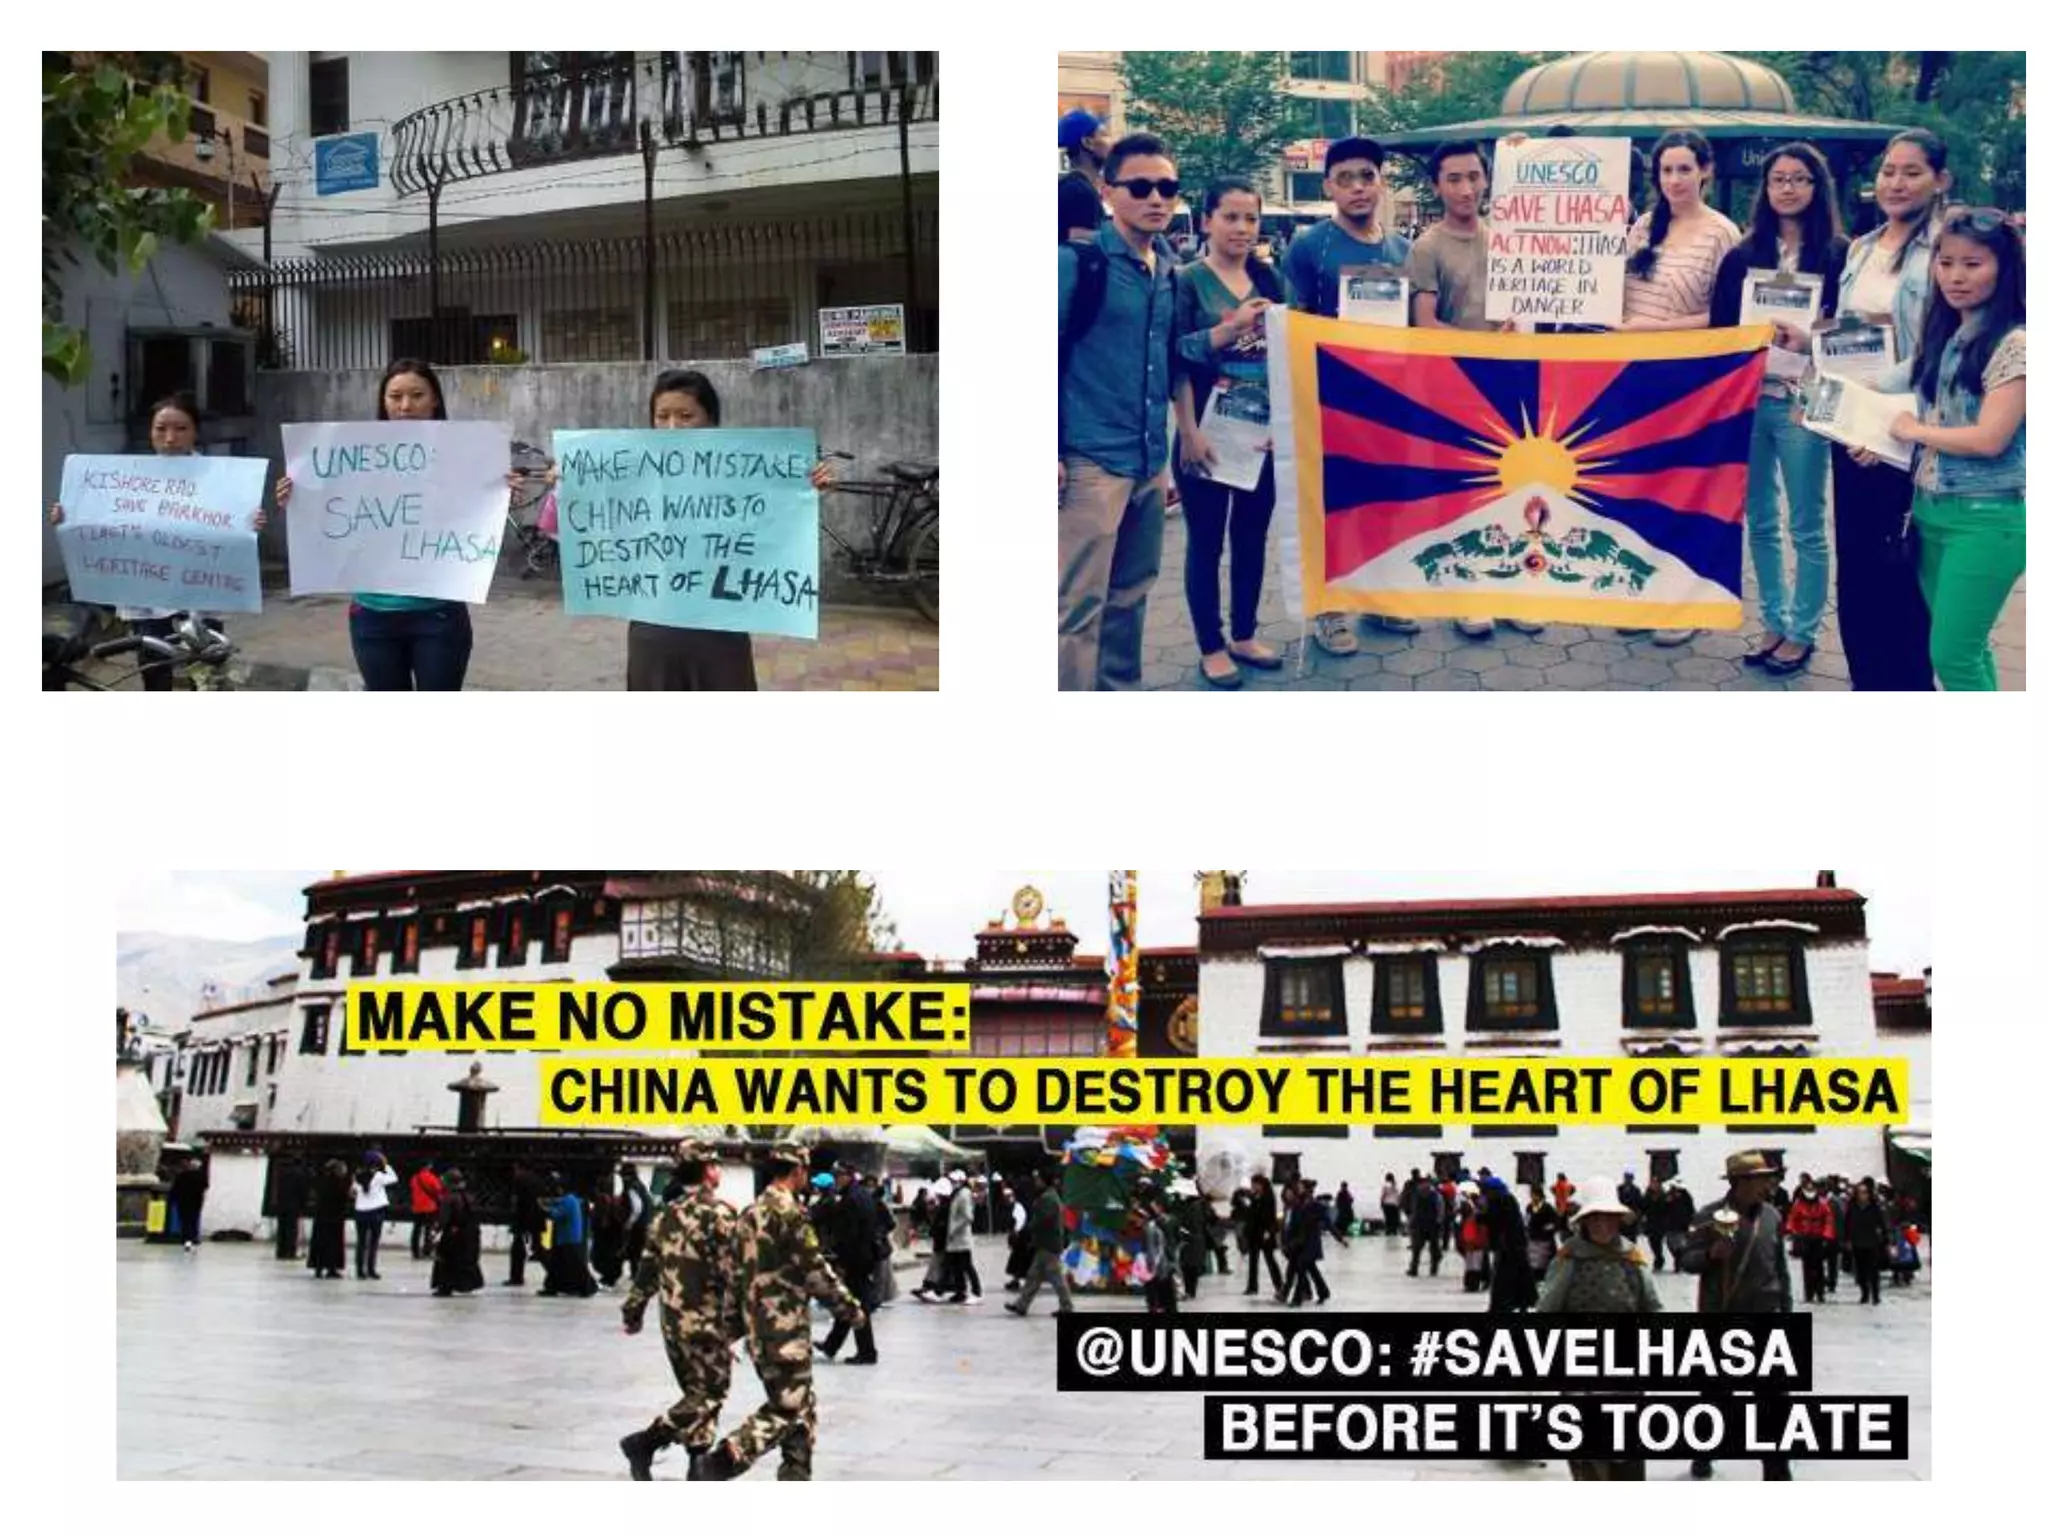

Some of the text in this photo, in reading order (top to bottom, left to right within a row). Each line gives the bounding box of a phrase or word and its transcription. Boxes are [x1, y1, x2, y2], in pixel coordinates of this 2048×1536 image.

[1516, 162, 1598, 184] UNESCO
[1493, 194, 1626, 224] SAVE LHASA
[1491, 233, 1524, 254] ACT
[1491, 258, 1591, 275] IS A WORLD
[1489, 277, 1598, 295] HERITAGE IN
[1511, 297, 1586, 319] DANGER
[84, 466, 161, 494] KISHORE
[561, 448, 631, 486] MAKE
[638, 449, 685, 478] NO
[323, 493, 424, 539] SAVE
[568, 493, 766, 533] CHINA WANTS TO
[400, 528, 501, 564] LHASA
[575, 532, 755, 568] DESTROY THE
[585, 565, 818, 610] HEART OF LHASA
